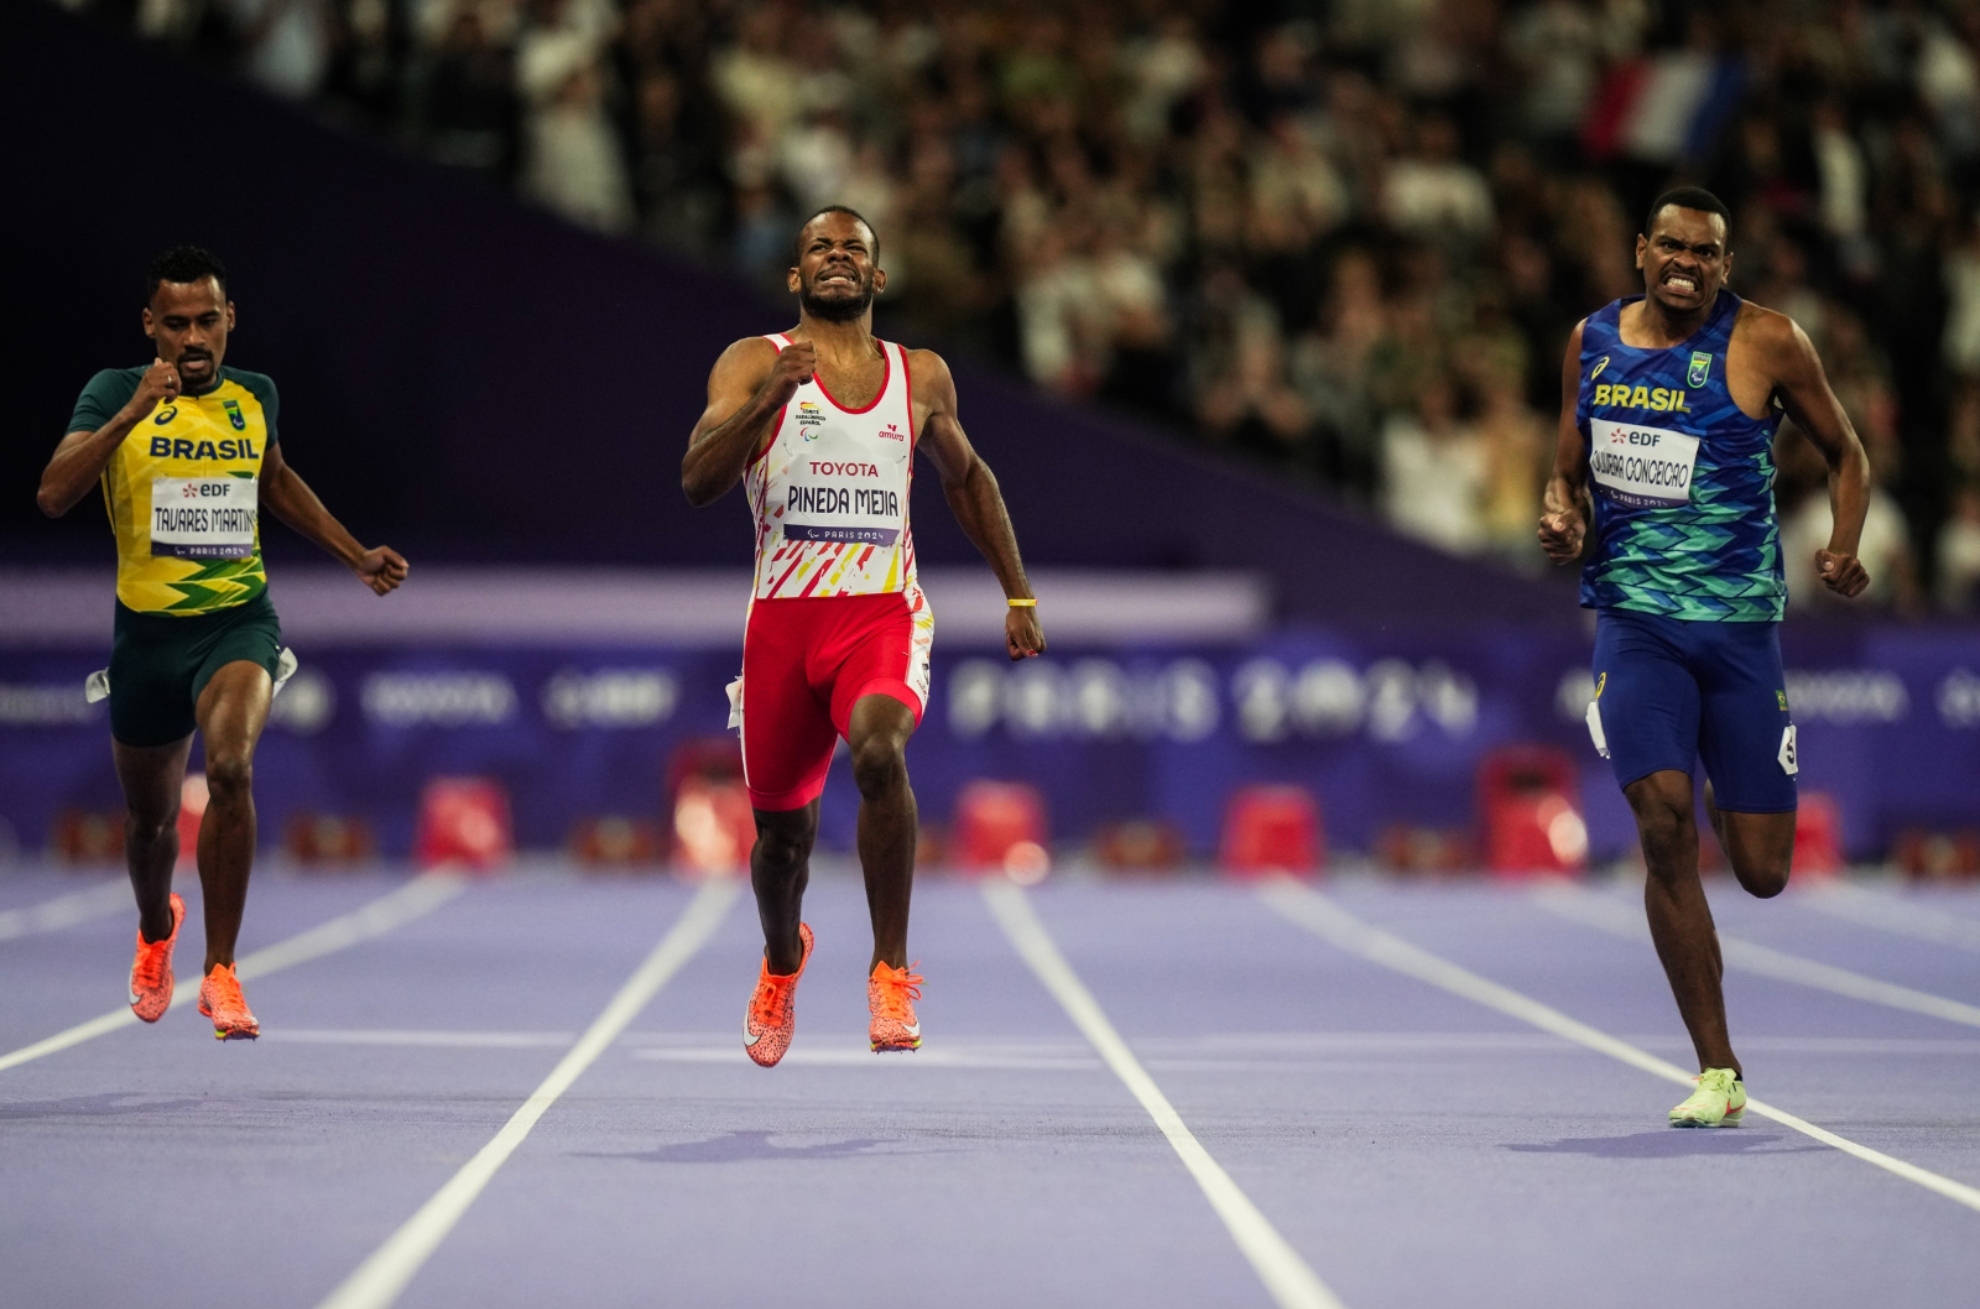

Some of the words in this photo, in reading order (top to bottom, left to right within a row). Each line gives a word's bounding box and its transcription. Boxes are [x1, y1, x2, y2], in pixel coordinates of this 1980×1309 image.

[1593, 384, 1691, 413] BRASIL
[878, 430, 904, 442] amura
[150, 436, 259, 460] BRASIL
[809, 461, 879, 477] TOYOTA
[1625, 457, 1689, 488] CONCEICAO
[788, 485, 850, 514] PINEDA
[855, 489, 898, 517] MEJIA
[1620, 494, 1642, 505] PARIS
[1644, 499, 1668, 507] 2024
[155, 507, 209, 532] TAVARES
[824, 530, 855, 539] PARIS
[857, 531, 884, 540] 2024
[190, 547, 217, 555] PARIS
[219, 547, 245, 555] 2024
